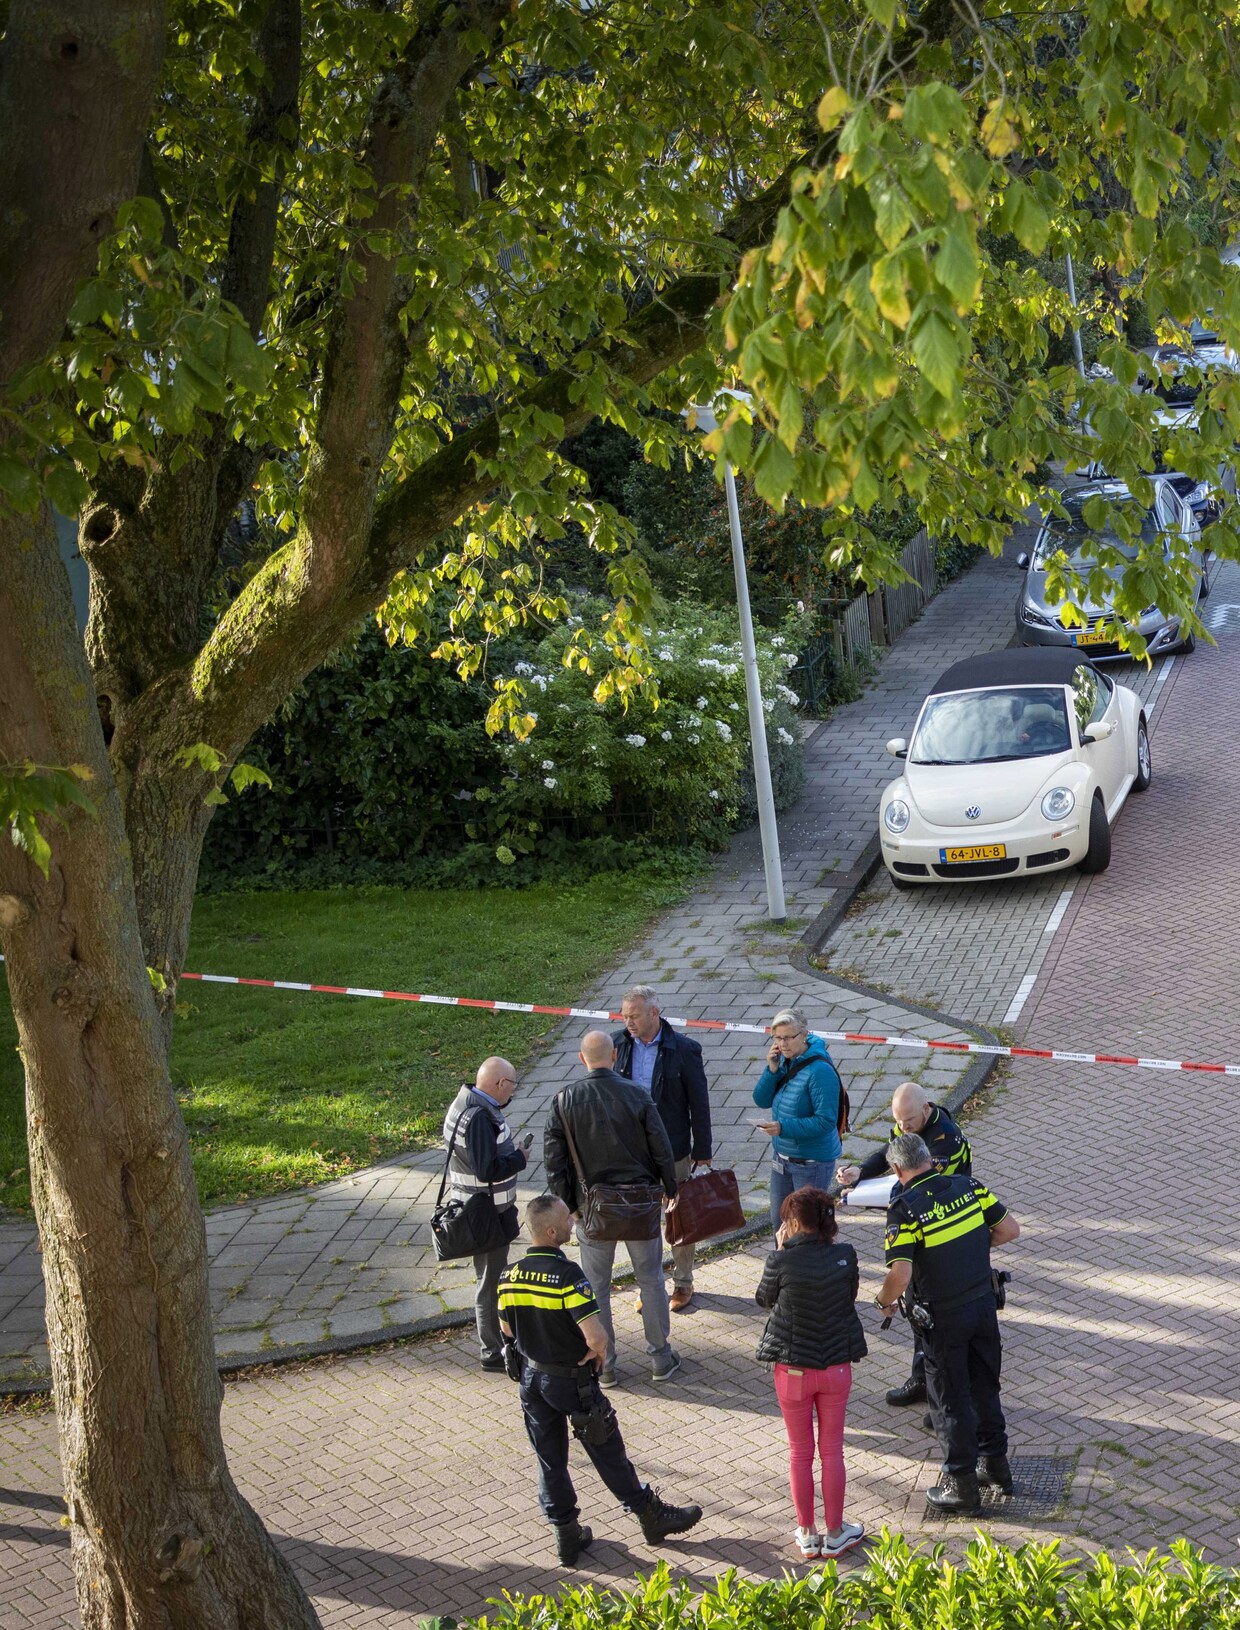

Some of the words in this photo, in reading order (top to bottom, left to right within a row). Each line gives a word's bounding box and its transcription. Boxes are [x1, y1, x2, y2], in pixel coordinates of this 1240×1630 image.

[951, 846, 1000, 860] 64-JVL-8
[927, 1194, 970, 1221] POLITIE
[505, 1266, 549, 1282] POLITIE
